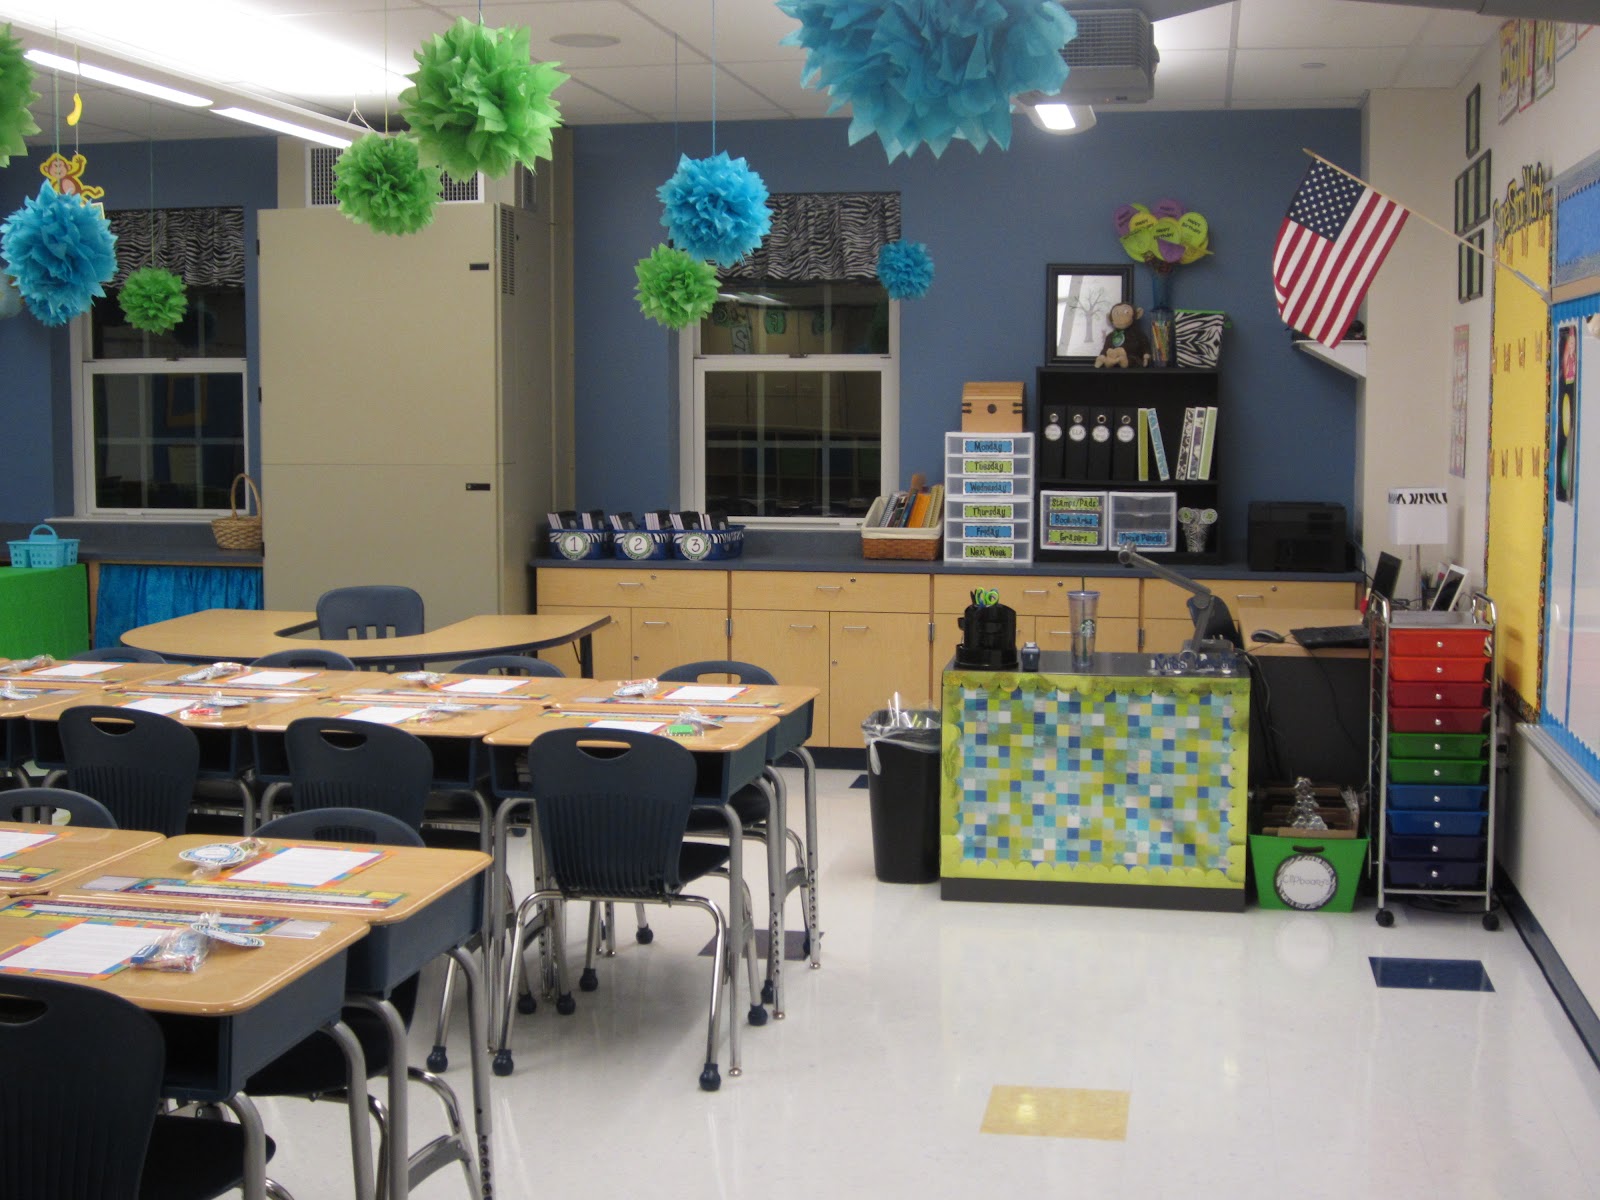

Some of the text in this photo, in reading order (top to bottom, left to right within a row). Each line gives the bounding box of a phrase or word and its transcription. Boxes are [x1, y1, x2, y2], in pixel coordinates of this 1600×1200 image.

[974, 441, 1003, 453] Monday
[974, 461, 1004, 473] Tuesday
[970, 482, 1007, 493] Wednesday
[1051, 498, 1096, 508] Stamps/Pads
[972, 506, 1006, 518] Thursday
[976, 526, 1000, 538] Friday
[1060, 532, 1088, 542] Erasers
[570, 536, 578, 551] 1
[634, 538, 643, 551] 2
[691, 538, 701, 552] 3
[970, 547, 1007, 557] Next Week
